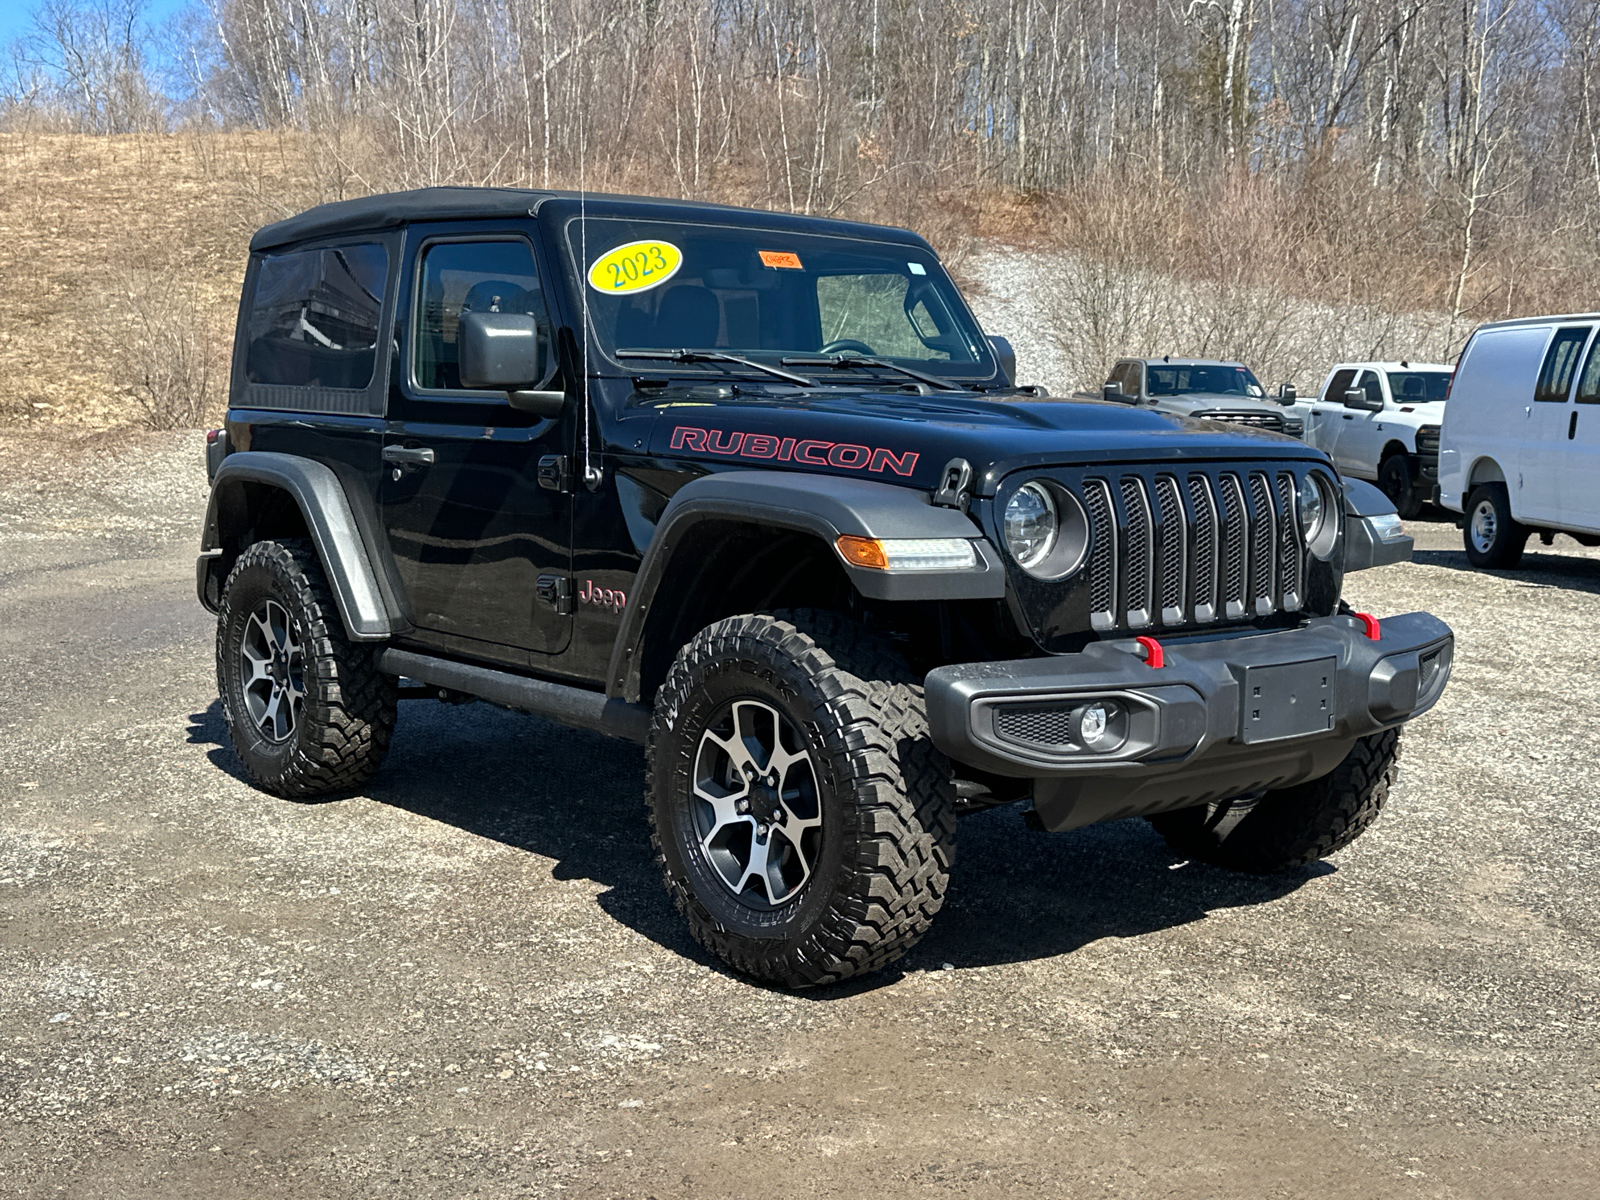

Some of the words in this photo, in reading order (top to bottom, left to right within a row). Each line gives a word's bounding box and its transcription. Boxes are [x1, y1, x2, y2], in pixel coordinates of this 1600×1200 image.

[606, 246, 667, 288] 2023
[670, 426, 920, 477] RUBICON
[579, 579, 627, 614] Jeep
